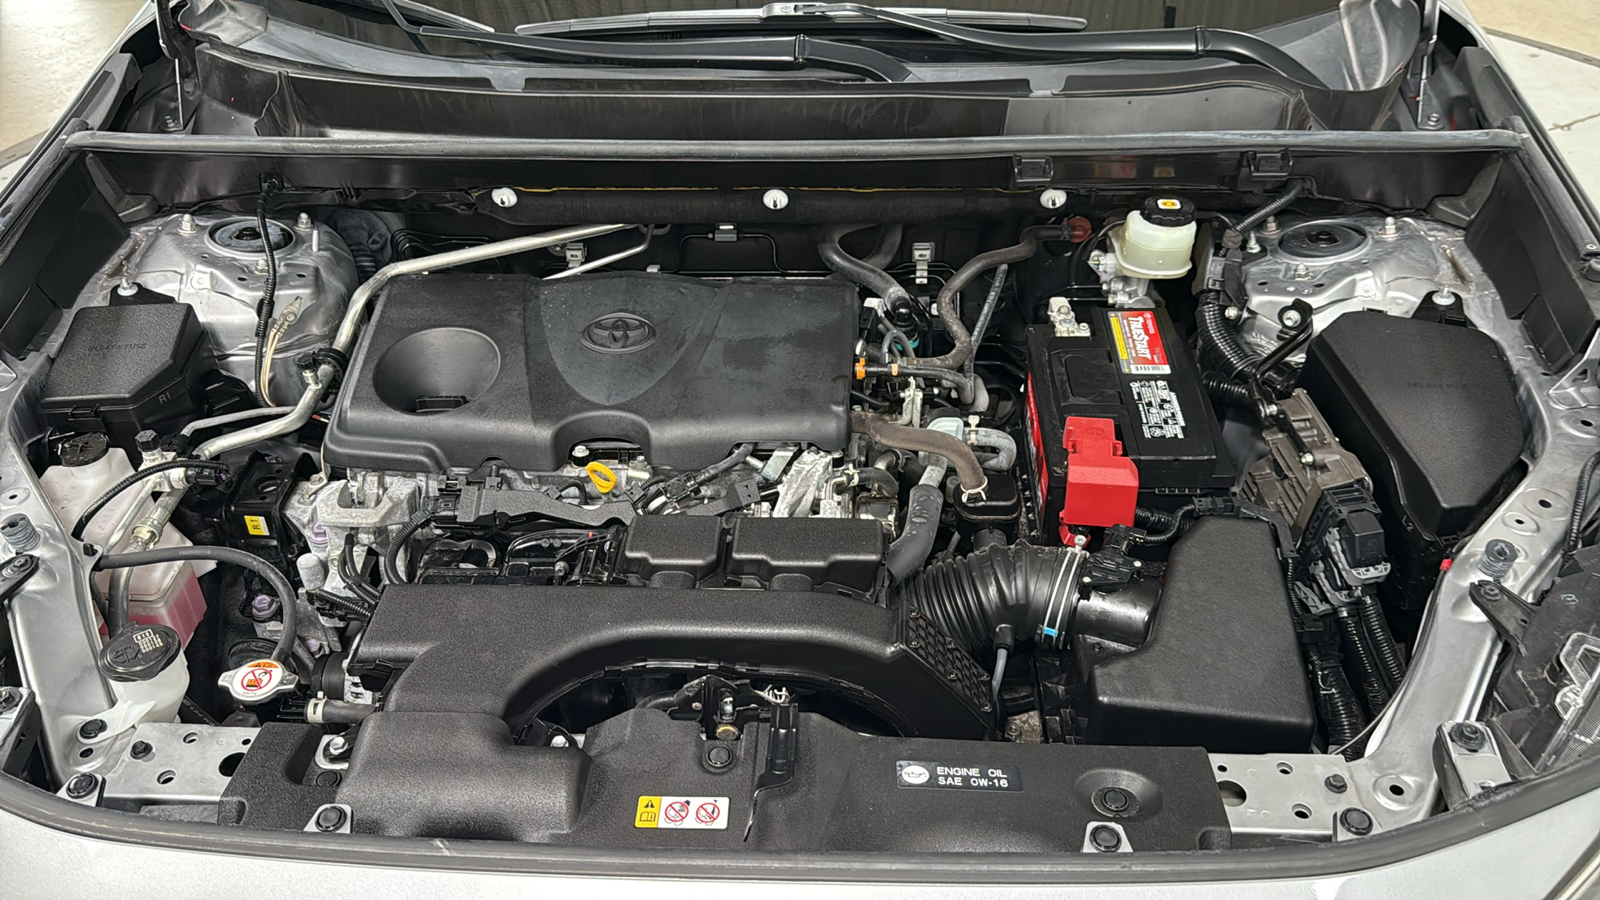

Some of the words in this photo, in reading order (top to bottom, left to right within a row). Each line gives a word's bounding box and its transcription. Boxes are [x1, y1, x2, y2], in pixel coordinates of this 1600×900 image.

[158, 391, 172, 405] R1
[937, 767, 980, 776] ENGINE
[988, 769, 1007, 777] OIL
[938, 777, 962, 785] SAE
[970, 778, 1008, 787] 0W-16
